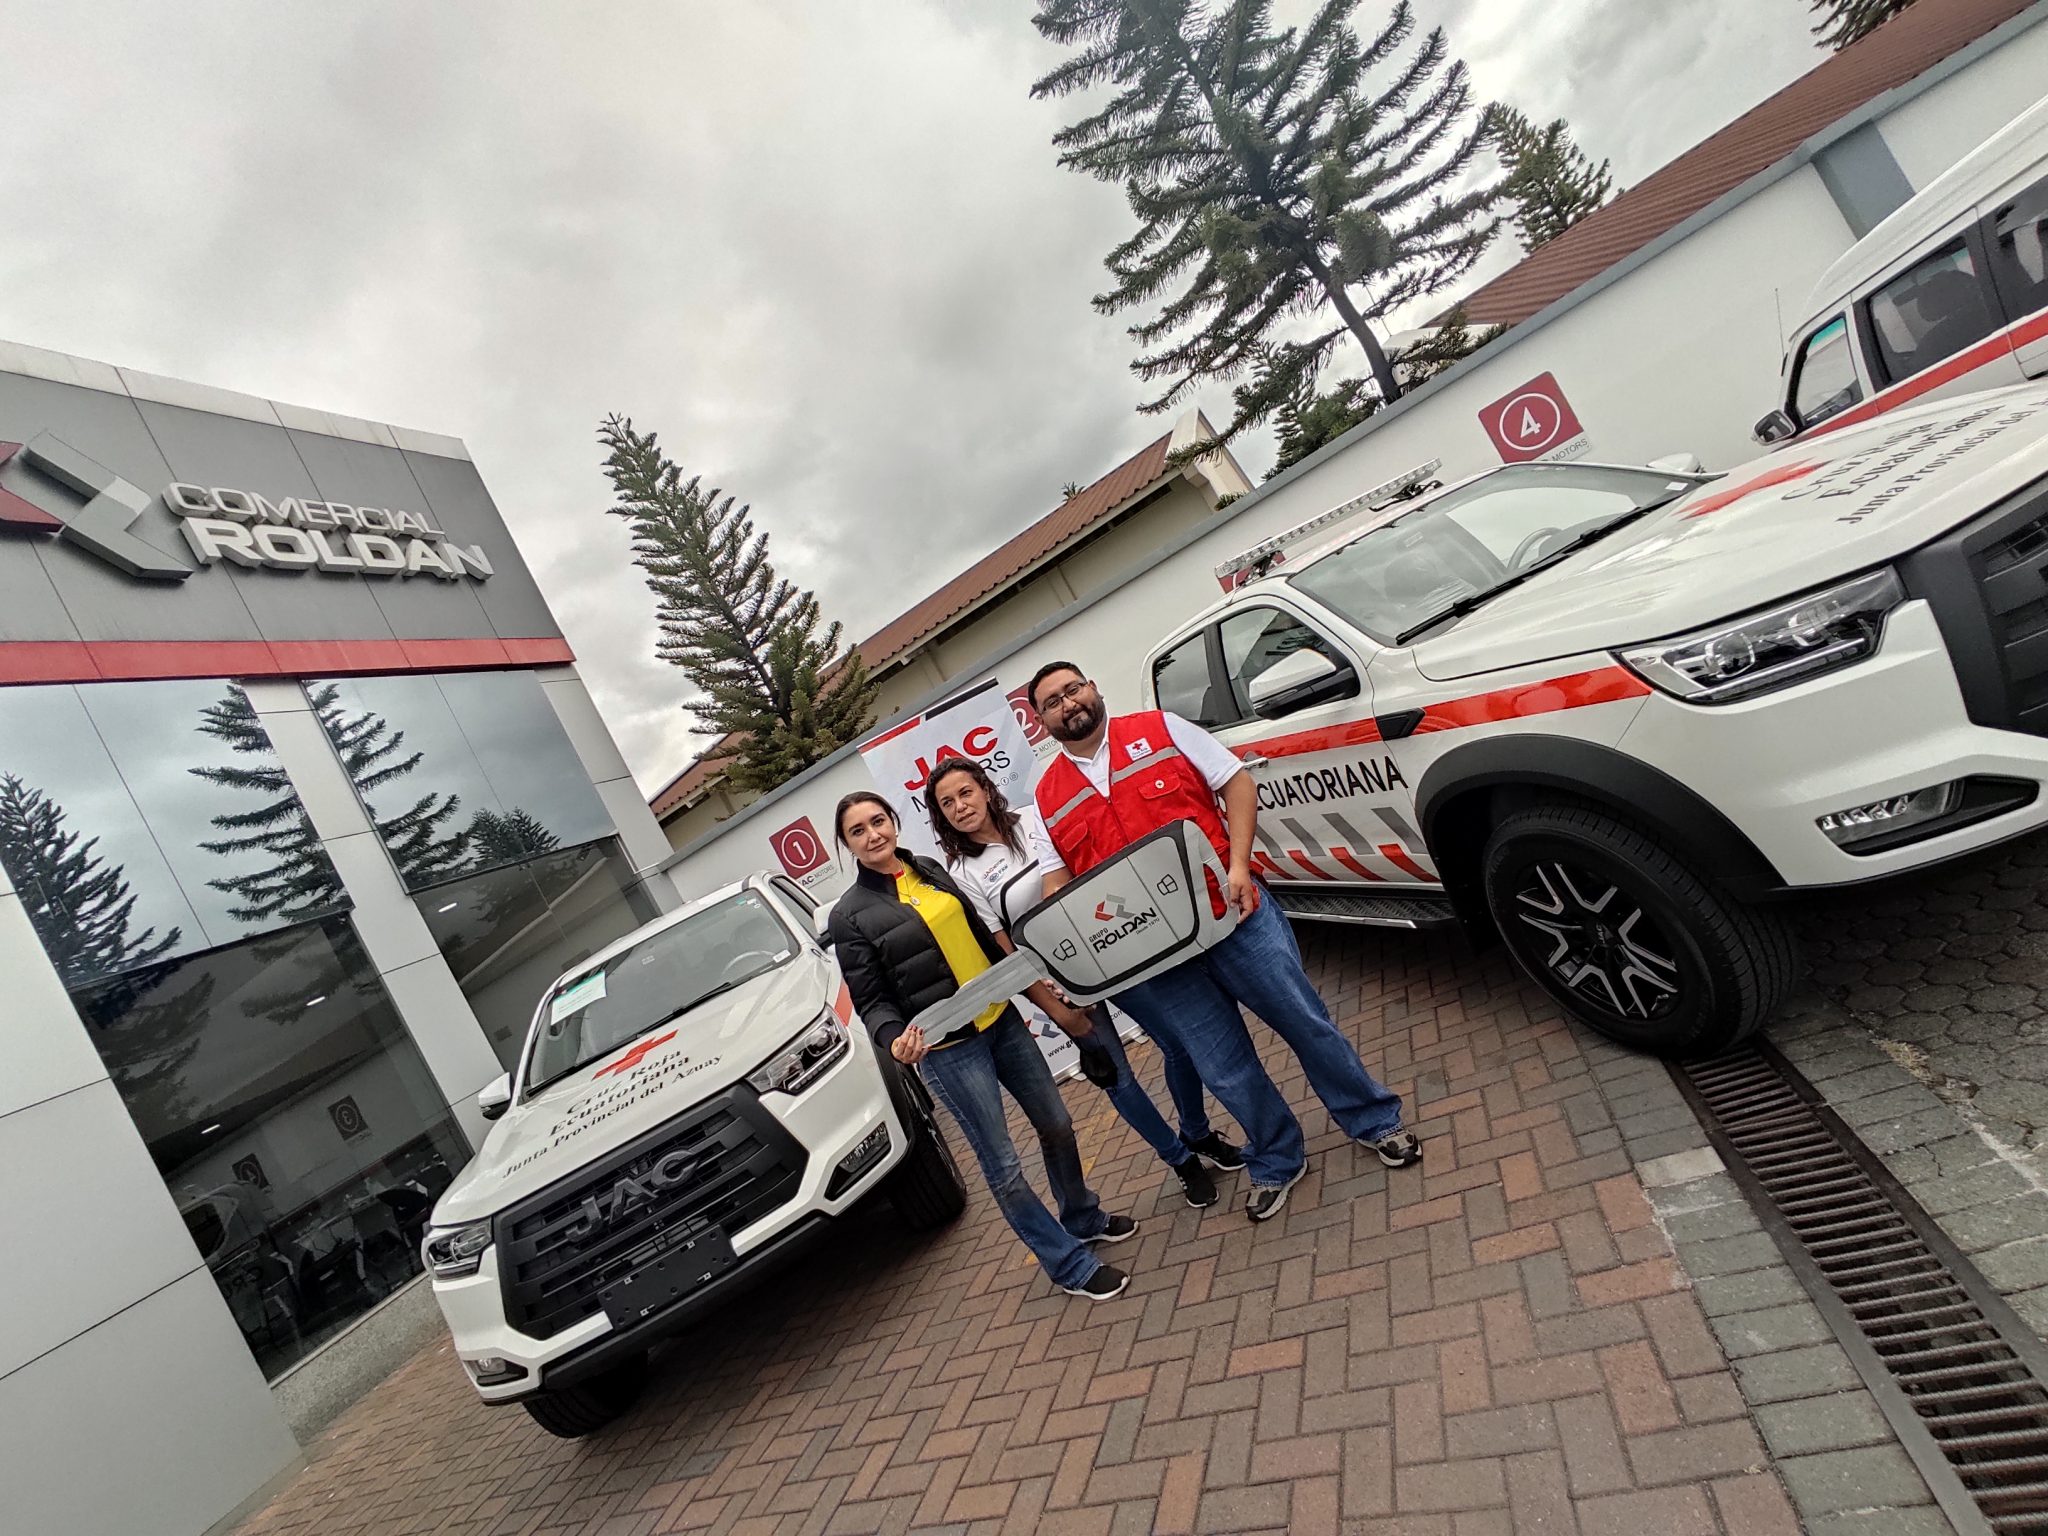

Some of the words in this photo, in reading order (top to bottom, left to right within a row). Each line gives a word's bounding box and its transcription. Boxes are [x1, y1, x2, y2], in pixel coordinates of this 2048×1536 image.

[1520, 406, 1541, 438] 4
[1551, 438, 1588, 462] MOTORS
[1812, 404, 2006, 500] Ecuatoriana
[162, 481, 445, 541] COMERCIAL
[1836, 485, 1909, 524] Junta
[180, 517, 494, 581] ROLDAN
[1014, 708, 1034, 731] 2
[1039, 739, 1058, 752] MOTO
[793, 841, 807, 860] 1
[799, 875, 815, 886] AC
[1089, 927, 1109, 943] GRUPO
[1093, 907, 1157, 953] ROLDAN
[550, 1055, 689, 1137] Ecuatoriana
[567, 1081, 623, 1114] Cruz
[630, 1050, 681, 1081] Roja
[502, 1146, 548, 1179] Junta
[553, 1097, 636, 1147] Provincial
[640, 1081, 664, 1099] del
[671, 1054, 723, 1084] Azuay
[565, 1149, 698, 1243] JAC
